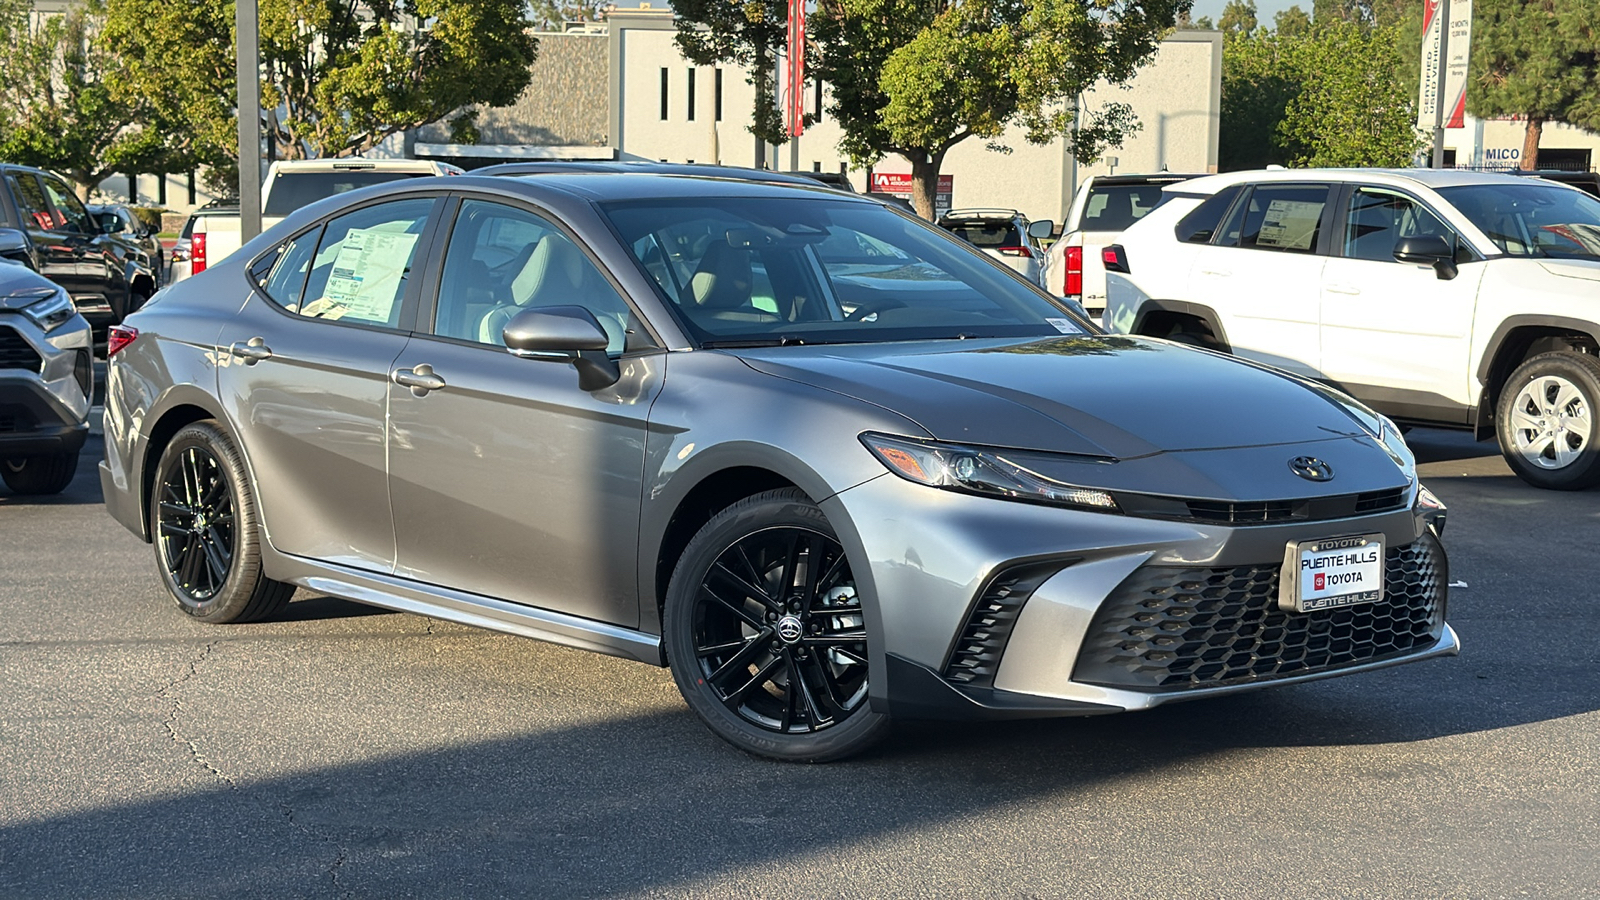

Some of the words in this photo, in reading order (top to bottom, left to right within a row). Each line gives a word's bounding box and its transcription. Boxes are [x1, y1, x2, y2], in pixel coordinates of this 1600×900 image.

[1432, 17, 1440, 79] VEHICLES
[1423, 51, 1432, 114] CERTIFIED
[1429, 82, 1437, 114] USED
[1486, 148, 1519, 159] MICO
[1319, 538, 1362, 550] TOYOTA
[1301, 555, 1343, 570] PUENTE
[1346, 552, 1377, 565] HILLS
[1327, 572, 1363, 586] TOYOTA
[1303, 596, 1346, 610] PUENTE
[1347, 592, 1378, 602] HILLS
